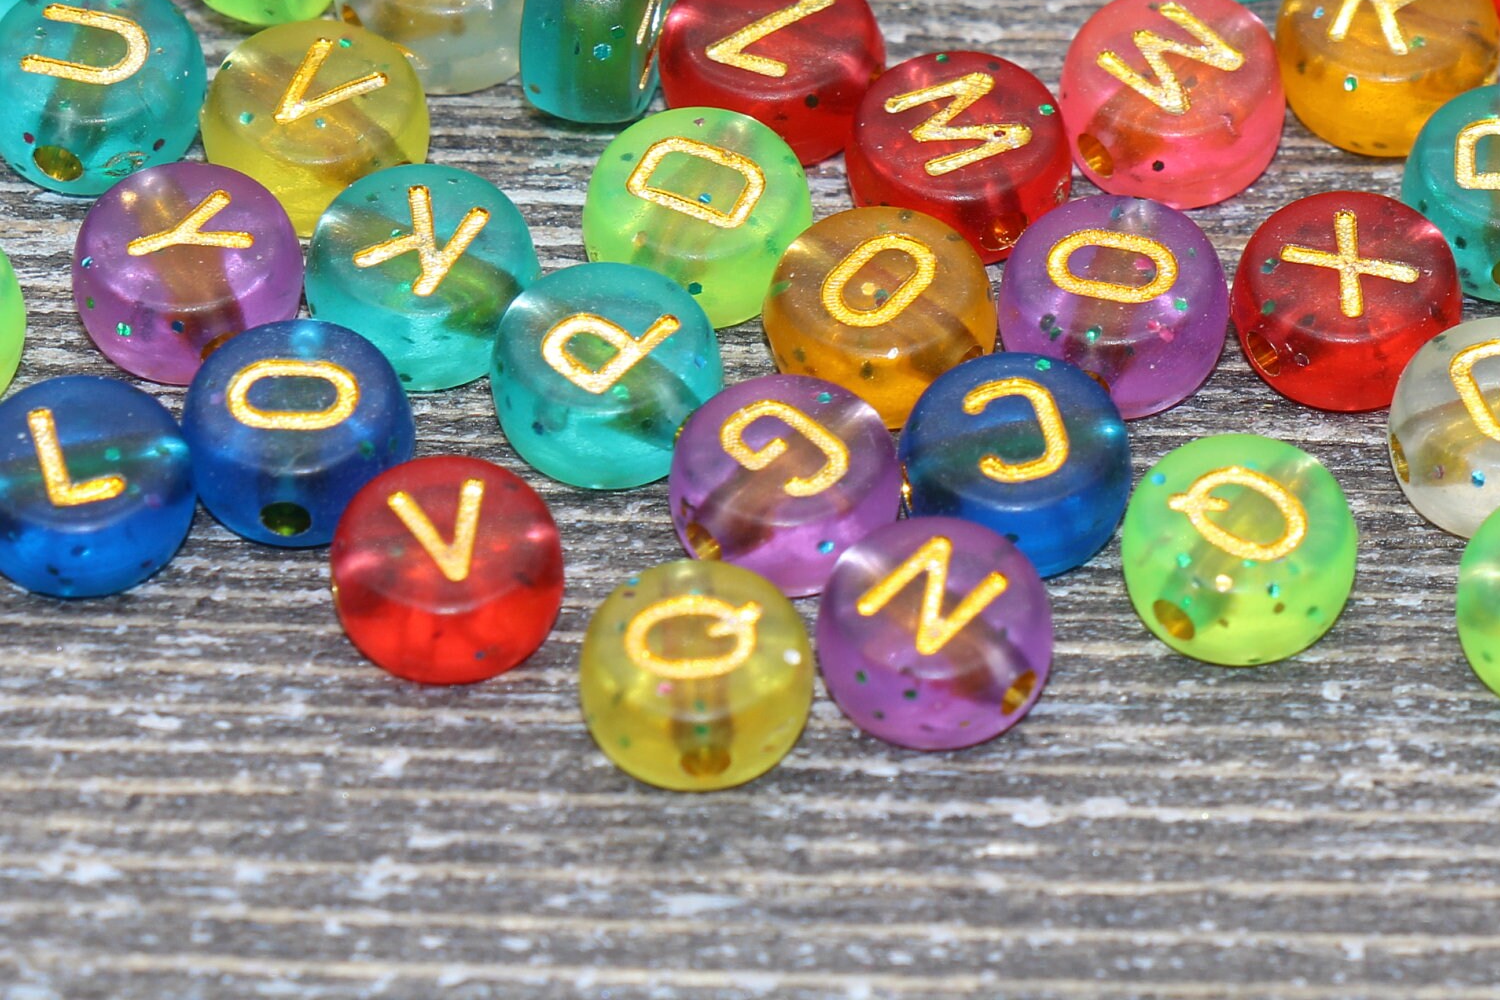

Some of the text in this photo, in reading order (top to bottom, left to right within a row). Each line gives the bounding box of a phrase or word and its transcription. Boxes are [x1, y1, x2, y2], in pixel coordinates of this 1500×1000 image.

[19, 3, 150, 85] U
[273, 38, 389, 125] V
[127, 189, 256, 257] Y
[625, 136, 768, 230] D
[352, 185, 491, 297] K
[821, 231, 938, 329] O
[1046, 229, 1179, 304] O
[1279, 209, 1421, 318] X
[226, 358, 361, 431] O
[542, 312, 682, 395] P
[27, 408, 128, 508] L
[719, 399, 850, 498] G
[962, 376, 1070, 484] C
[387, 478, 486, 582] V
[1166, 463, 1309, 562] Q
[620, 592, 766, 681] Q
